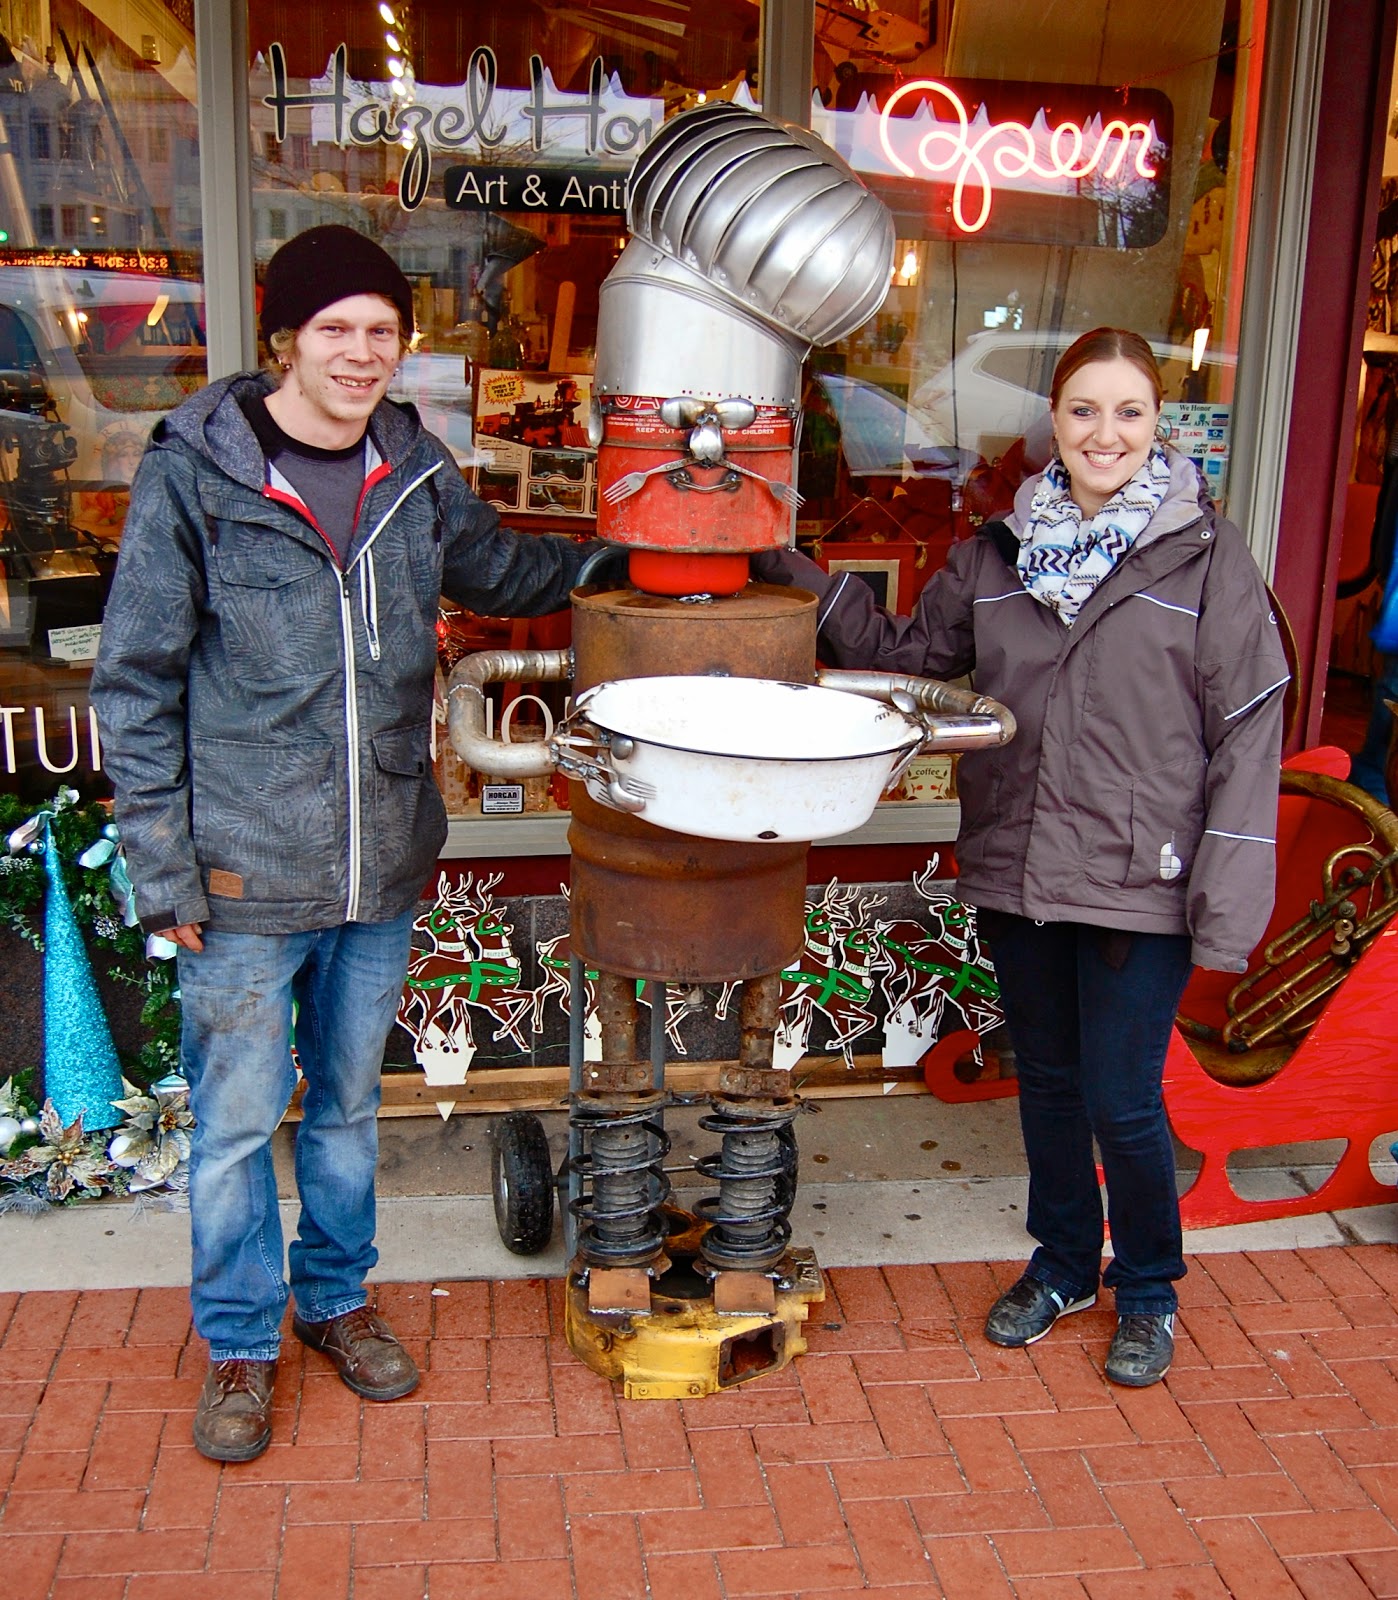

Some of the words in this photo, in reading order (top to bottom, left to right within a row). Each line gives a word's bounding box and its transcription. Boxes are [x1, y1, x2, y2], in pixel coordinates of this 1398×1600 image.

[262, 42, 507, 212] Hazel
[521, 54, 653, 157] Ho
[880, 80, 1156, 233] Open
[456, 171, 508, 205] Art
[521, 174, 549, 207] &
[560, 175, 629, 210] Anti
[635, 426, 657, 434] KEEP
[658, 427, 675, 435] OUT
[915, 767, 940, 776] coffee
[808, 942, 830, 953] COMET
[846, 962, 868, 973] CUPID
[980, 960, 994, 970] VIXE
